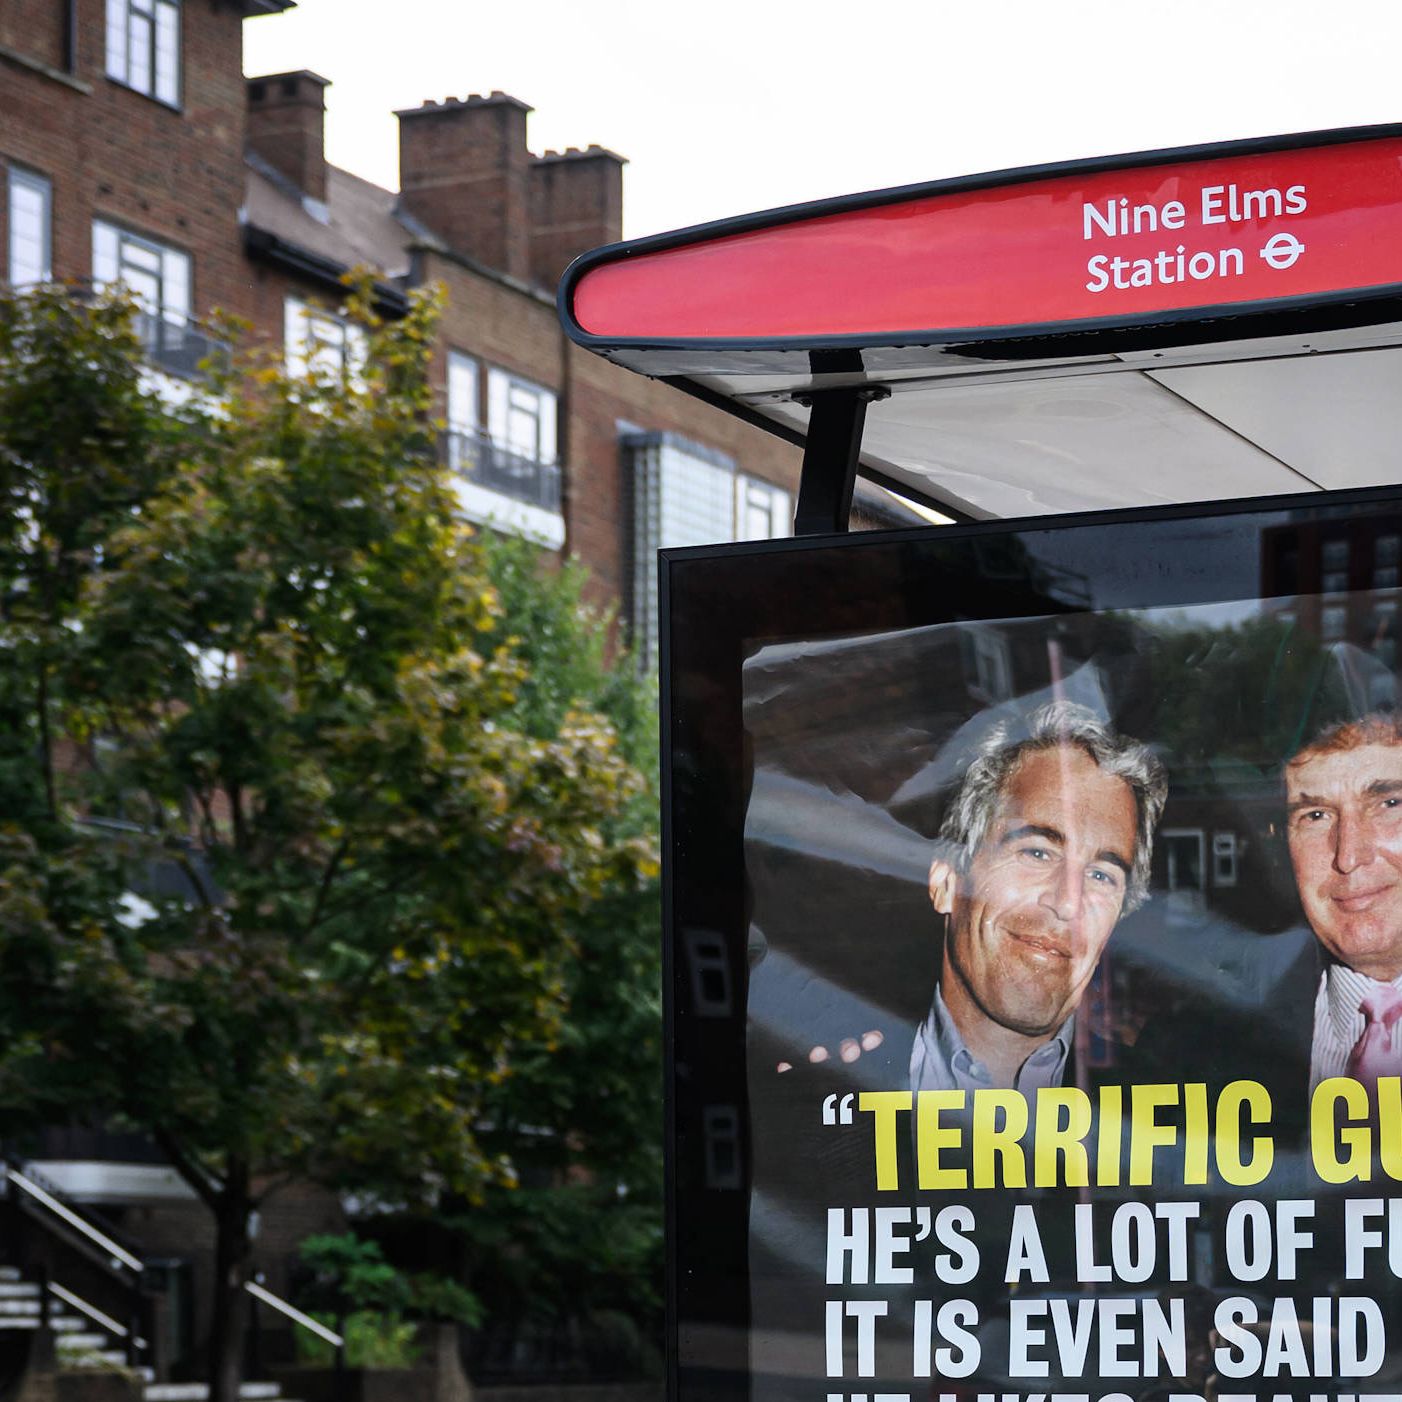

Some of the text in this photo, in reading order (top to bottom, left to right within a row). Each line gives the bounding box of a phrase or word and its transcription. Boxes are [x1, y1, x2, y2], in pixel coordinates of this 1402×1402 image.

[1083, 184, 1308, 240] Nine Elms
[1086, 245, 1244, 293] Station
[826, 1205, 979, 1284] HE’S
[1005, 1205, 1050, 1282] A
[1075, 1202, 1199, 1282] LOT
[1226, 1200, 1314, 1281] OF
[826, 1301, 888, 1377] IT
[914, 1299, 981, 1378] IS
[1009, 1299, 1186, 1377] EVEN
[1215, 1297, 1385, 1378] SAID
